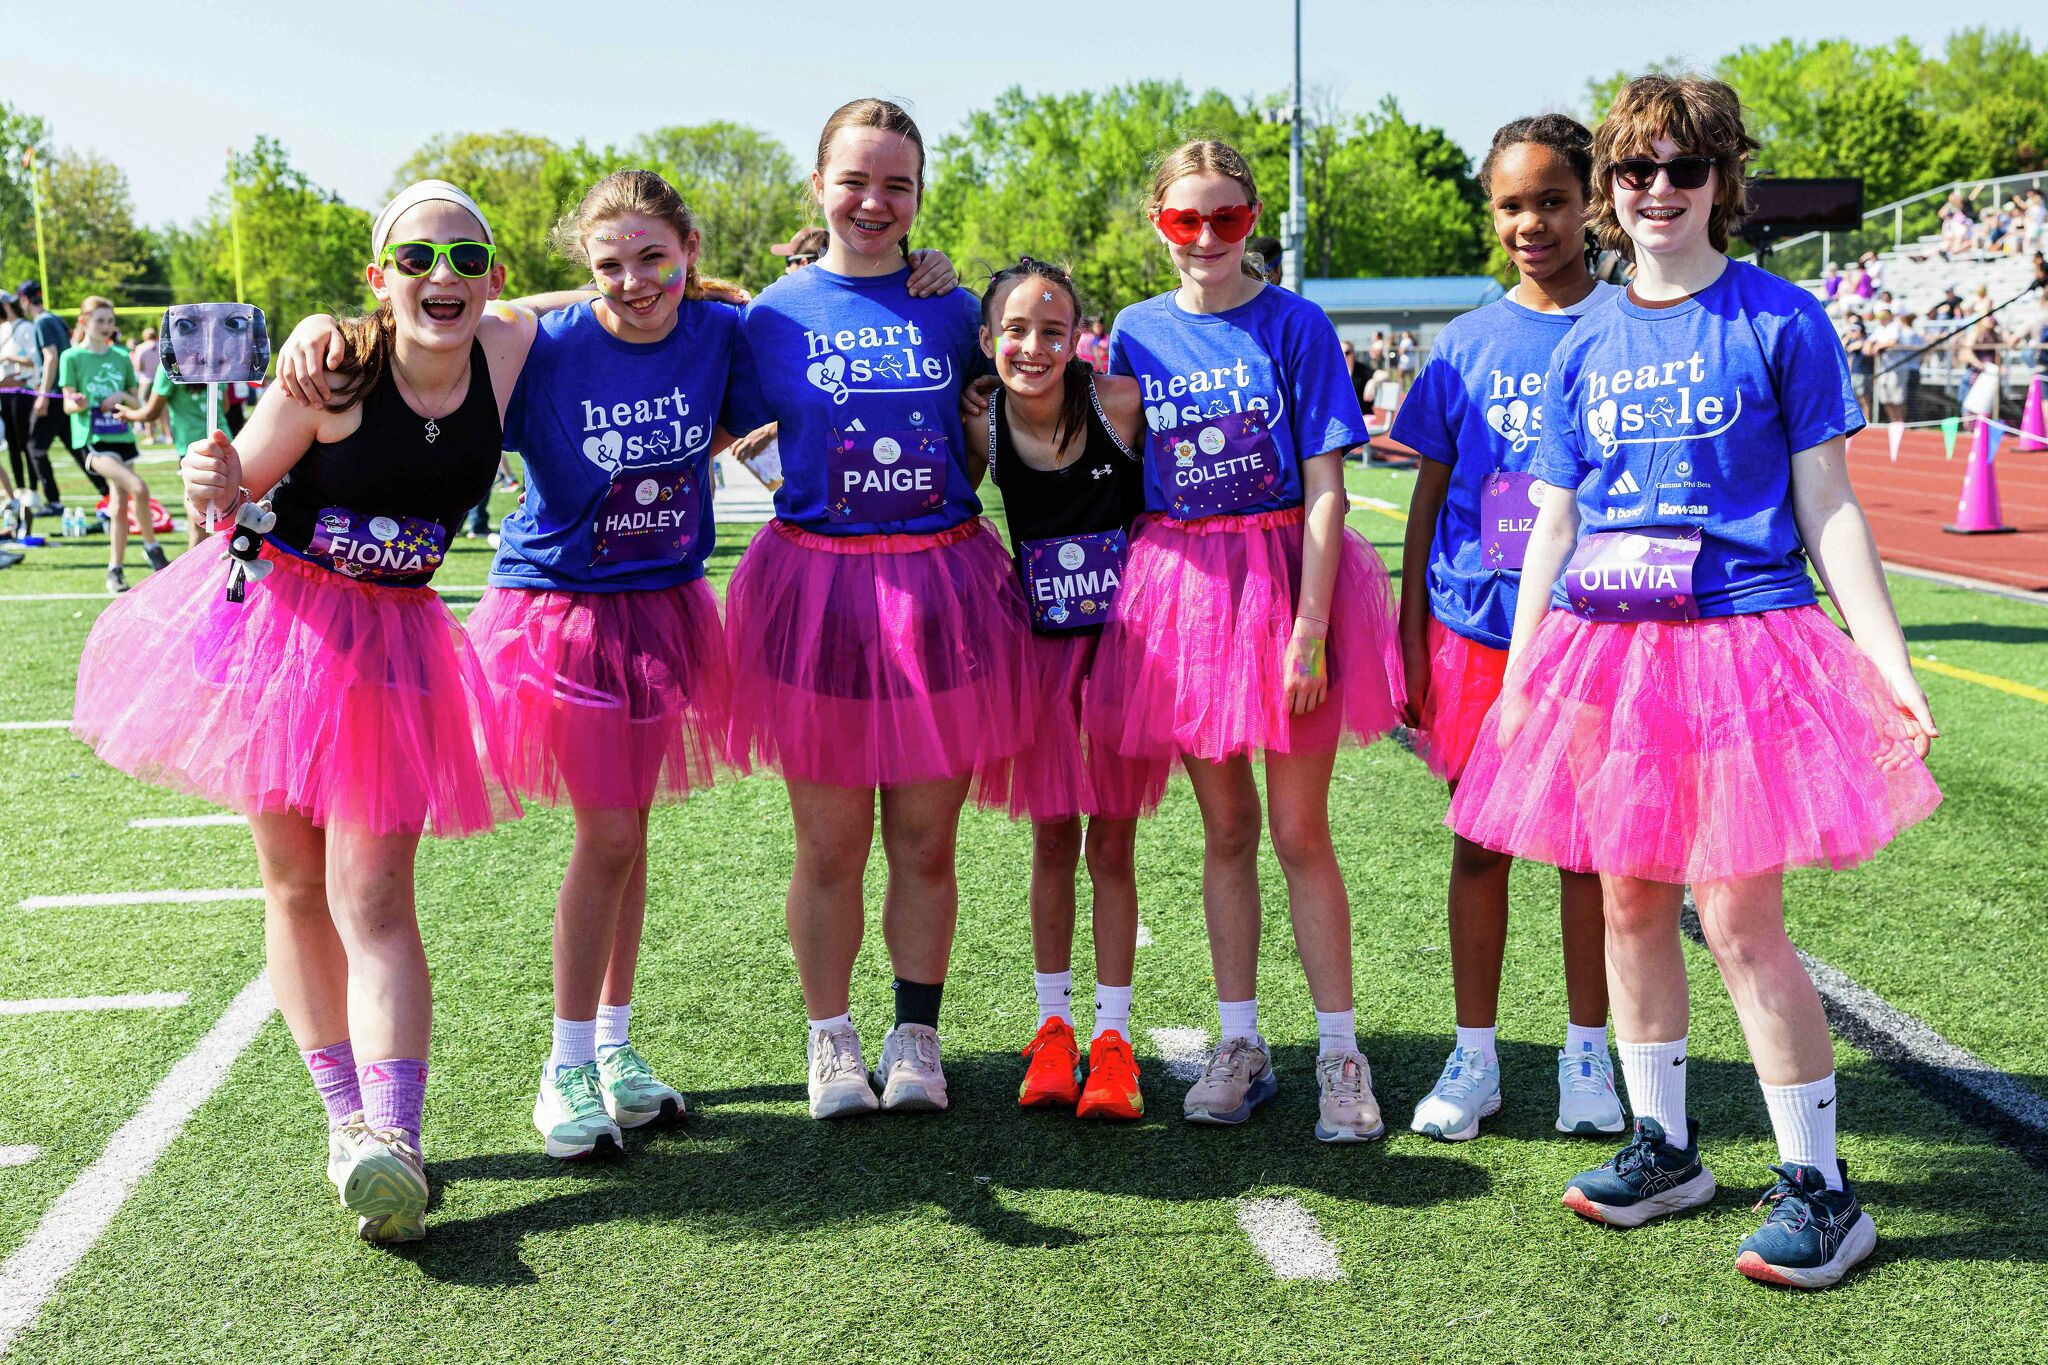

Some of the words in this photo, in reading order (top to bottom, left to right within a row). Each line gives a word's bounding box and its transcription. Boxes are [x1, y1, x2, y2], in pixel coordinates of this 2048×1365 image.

[803, 320, 922, 359] heart
[1141, 357, 1250, 401] heart
[1587, 351, 1705, 405] heart
[581, 387, 689, 431] heart
[843, 468, 933, 492] PAIGE
[1175, 453, 1264, 487] COLETTE
[605, 510, 686, 532] HADLEY
[1498, 518, 1533, 532] ELIZ
[1658, 502, 1708, 515] Rowan
[328, 536, 424, 570] FIONA
[1035, 568, 1122, 601] EMMA
[1579, 565, 1677, 591] OLIVIA
